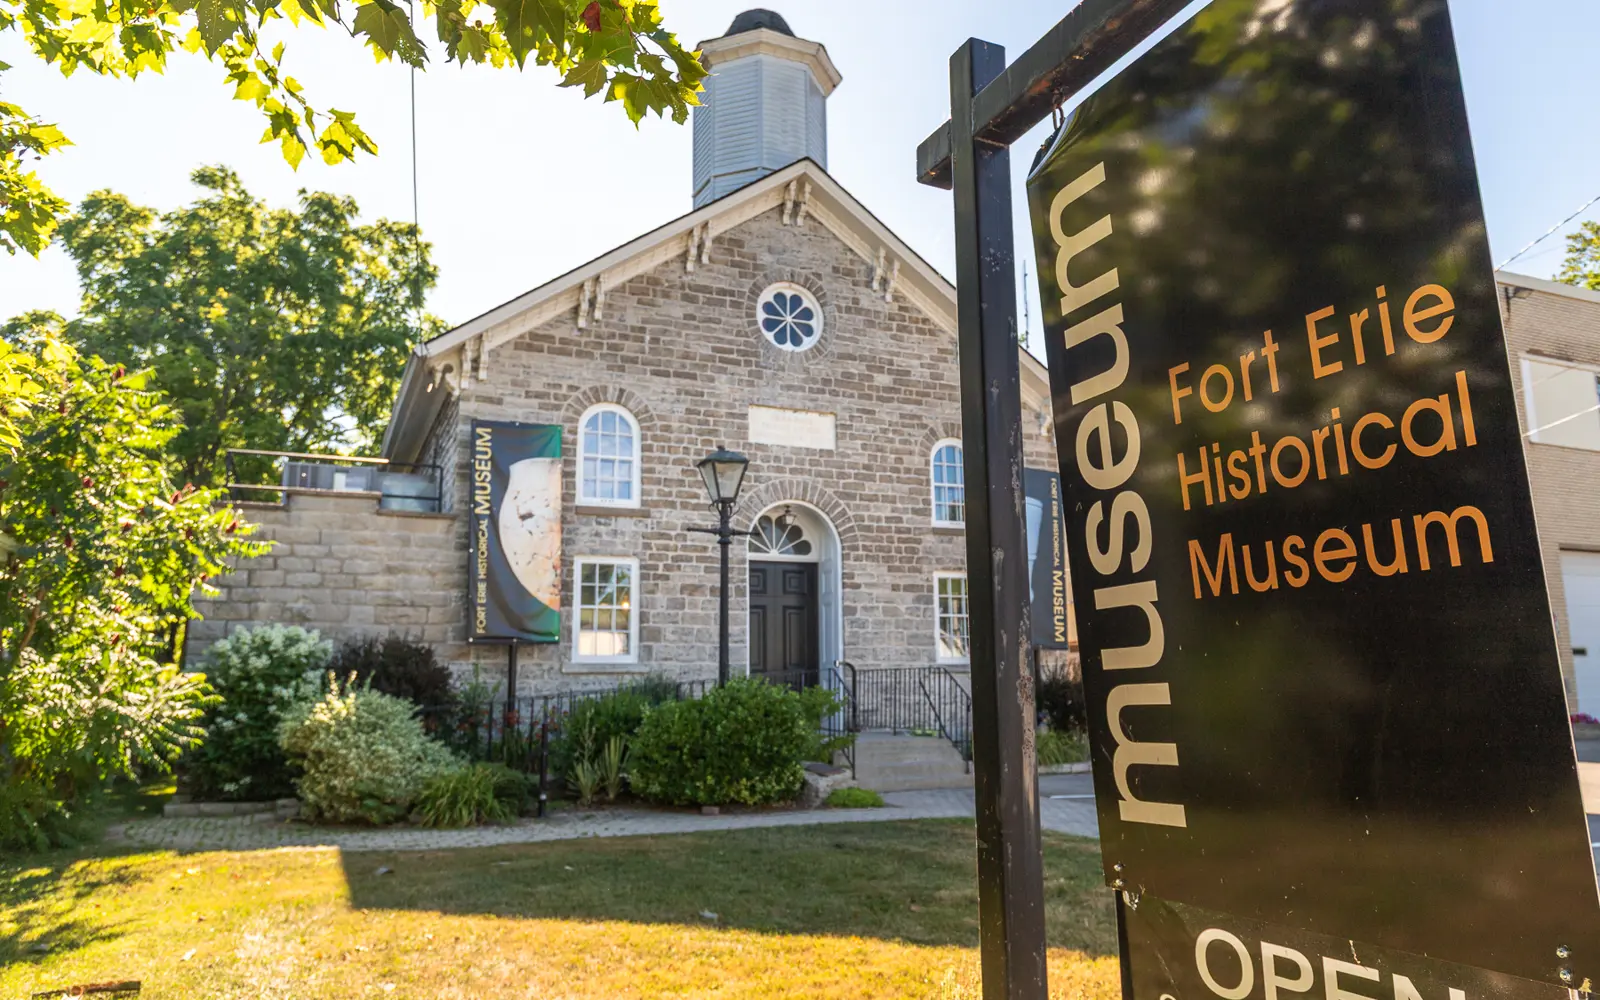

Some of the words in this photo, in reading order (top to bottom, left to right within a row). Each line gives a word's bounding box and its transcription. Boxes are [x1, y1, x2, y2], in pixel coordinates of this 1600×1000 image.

[1168, 329, 1282, 425] Fort
[1305, 284, 1456, 380] Erie
[474, 427, 492, 515] MUSEUM
[1177, 370, 1478, 511] Historical
[1049, 160, 1188, 828] museum
[477, 581, 487, 604] ERIE
[478, 518, 489, 579] HISTORICAL
[1187, 505, 1494, 600] Museum
[476, 606, 487, 634] FORT
[1052, 570, 1065, 642] MUSEUM
